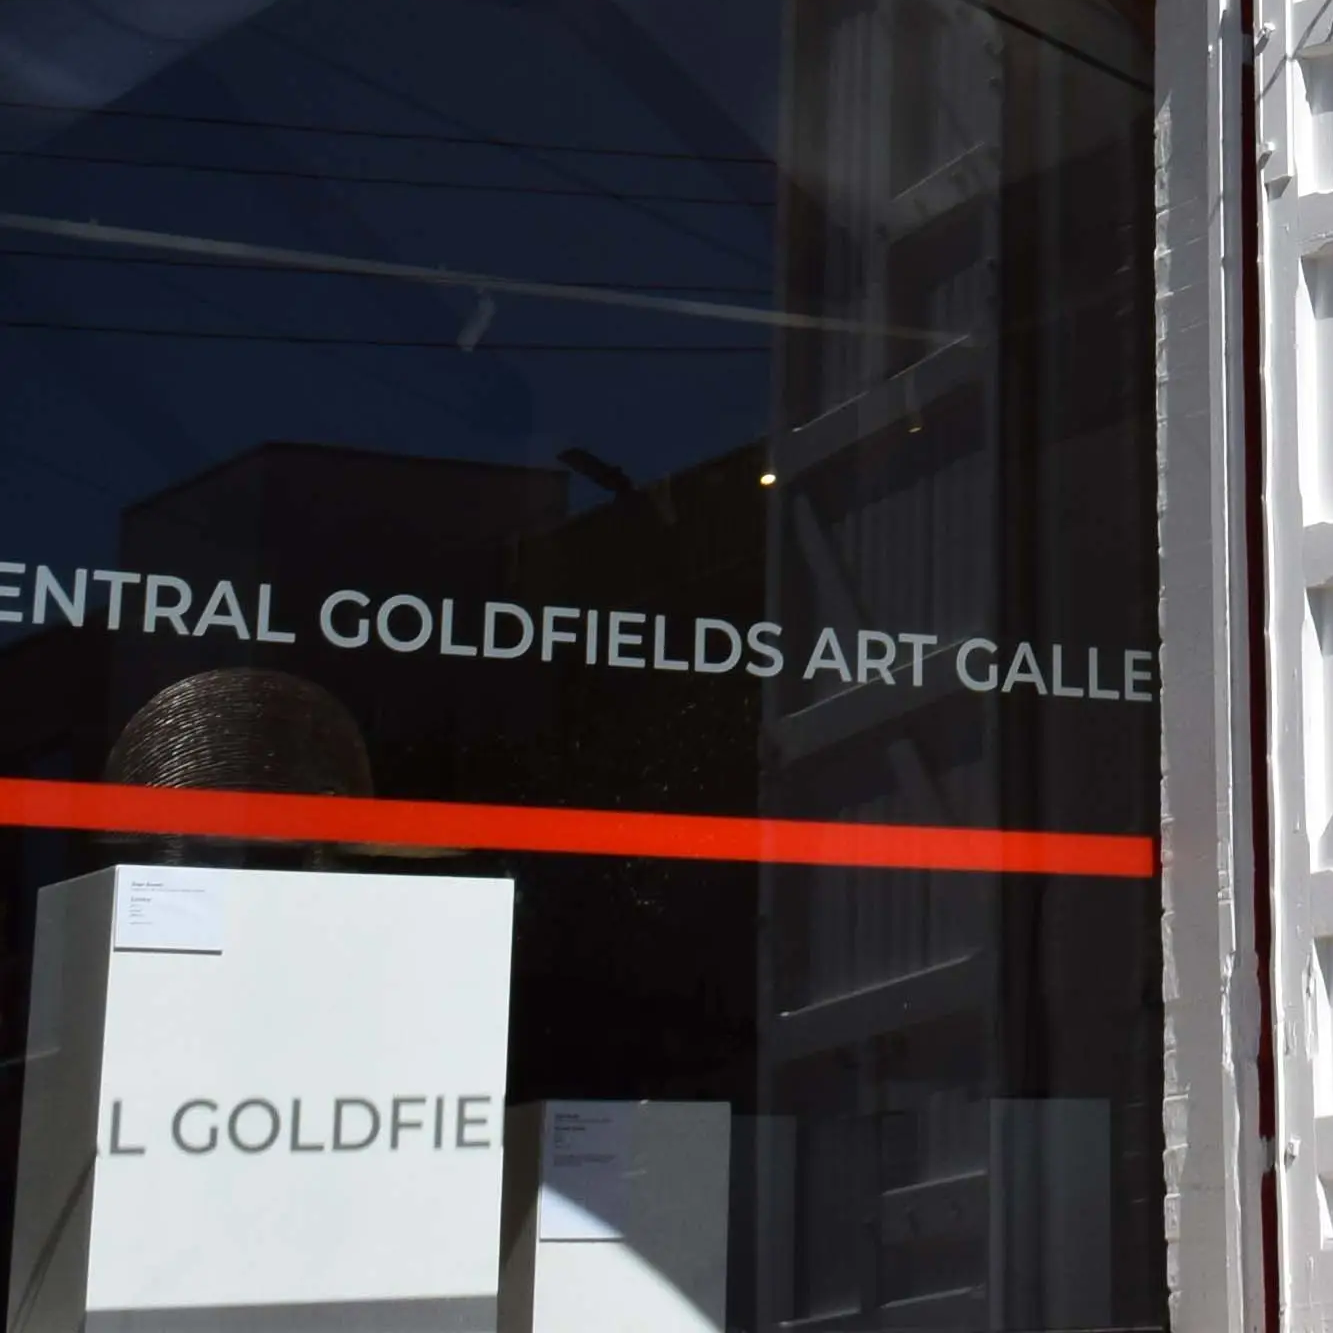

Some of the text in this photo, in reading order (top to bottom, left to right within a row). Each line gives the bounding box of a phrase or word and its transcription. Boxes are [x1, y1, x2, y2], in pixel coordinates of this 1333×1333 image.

[0, 562, 1152, 702] ENTRAL GOLDFIELDS ART GALLE
